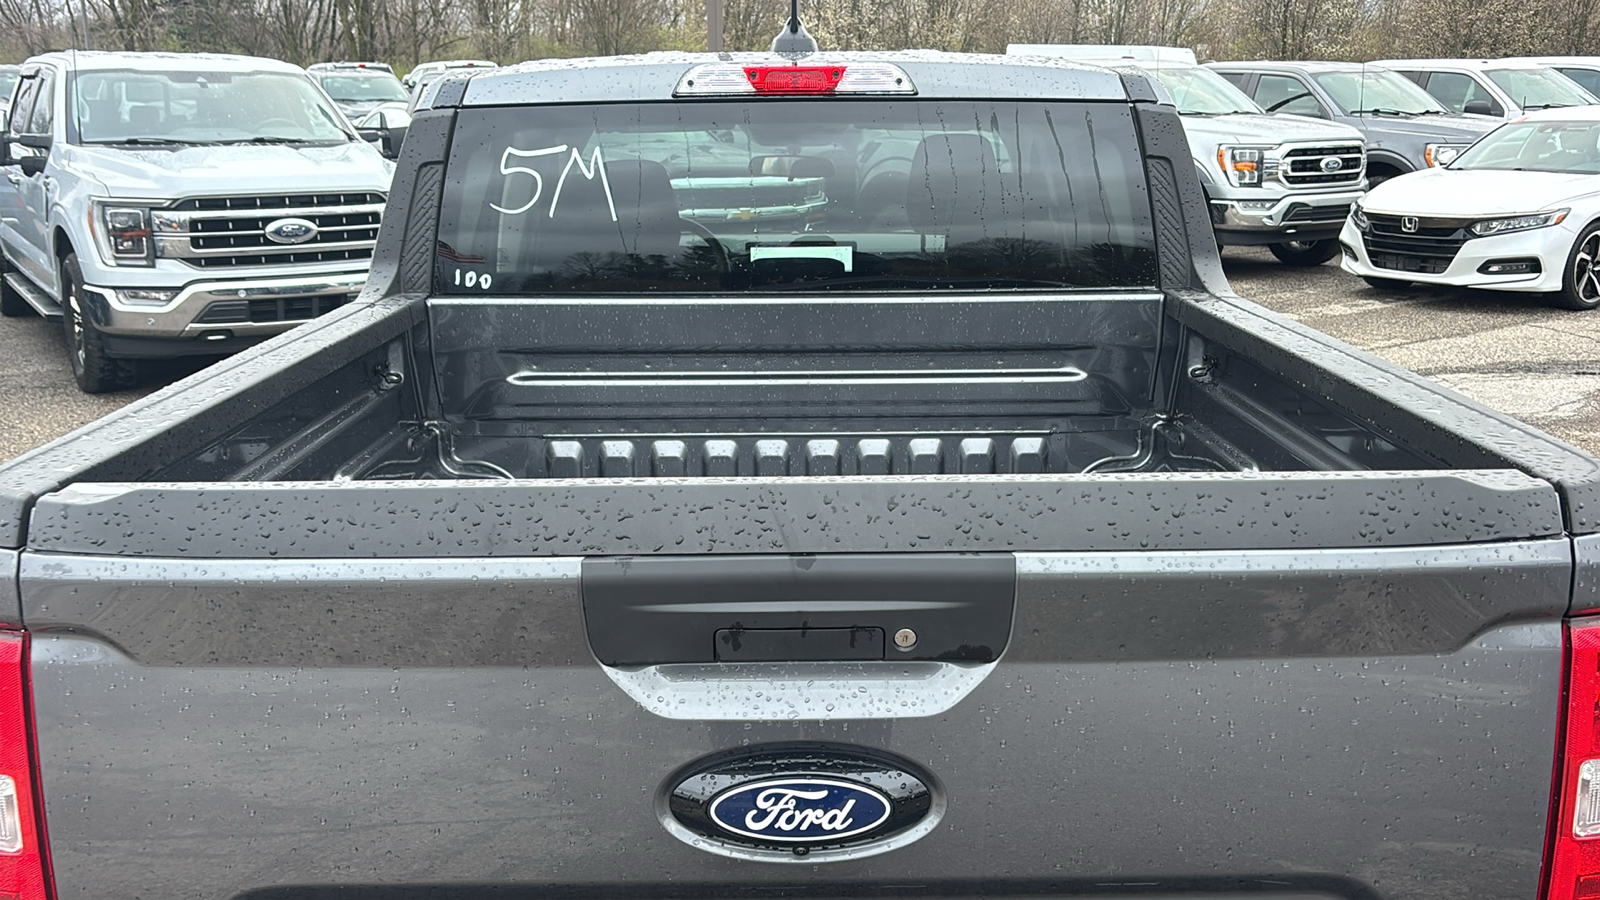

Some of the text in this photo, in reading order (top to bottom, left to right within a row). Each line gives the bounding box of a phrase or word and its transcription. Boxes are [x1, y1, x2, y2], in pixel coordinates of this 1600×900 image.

[489, 144, 618, 222] 5M
[454, 268, 492, 289] 100
[745, 788, 857, 831] Ford
